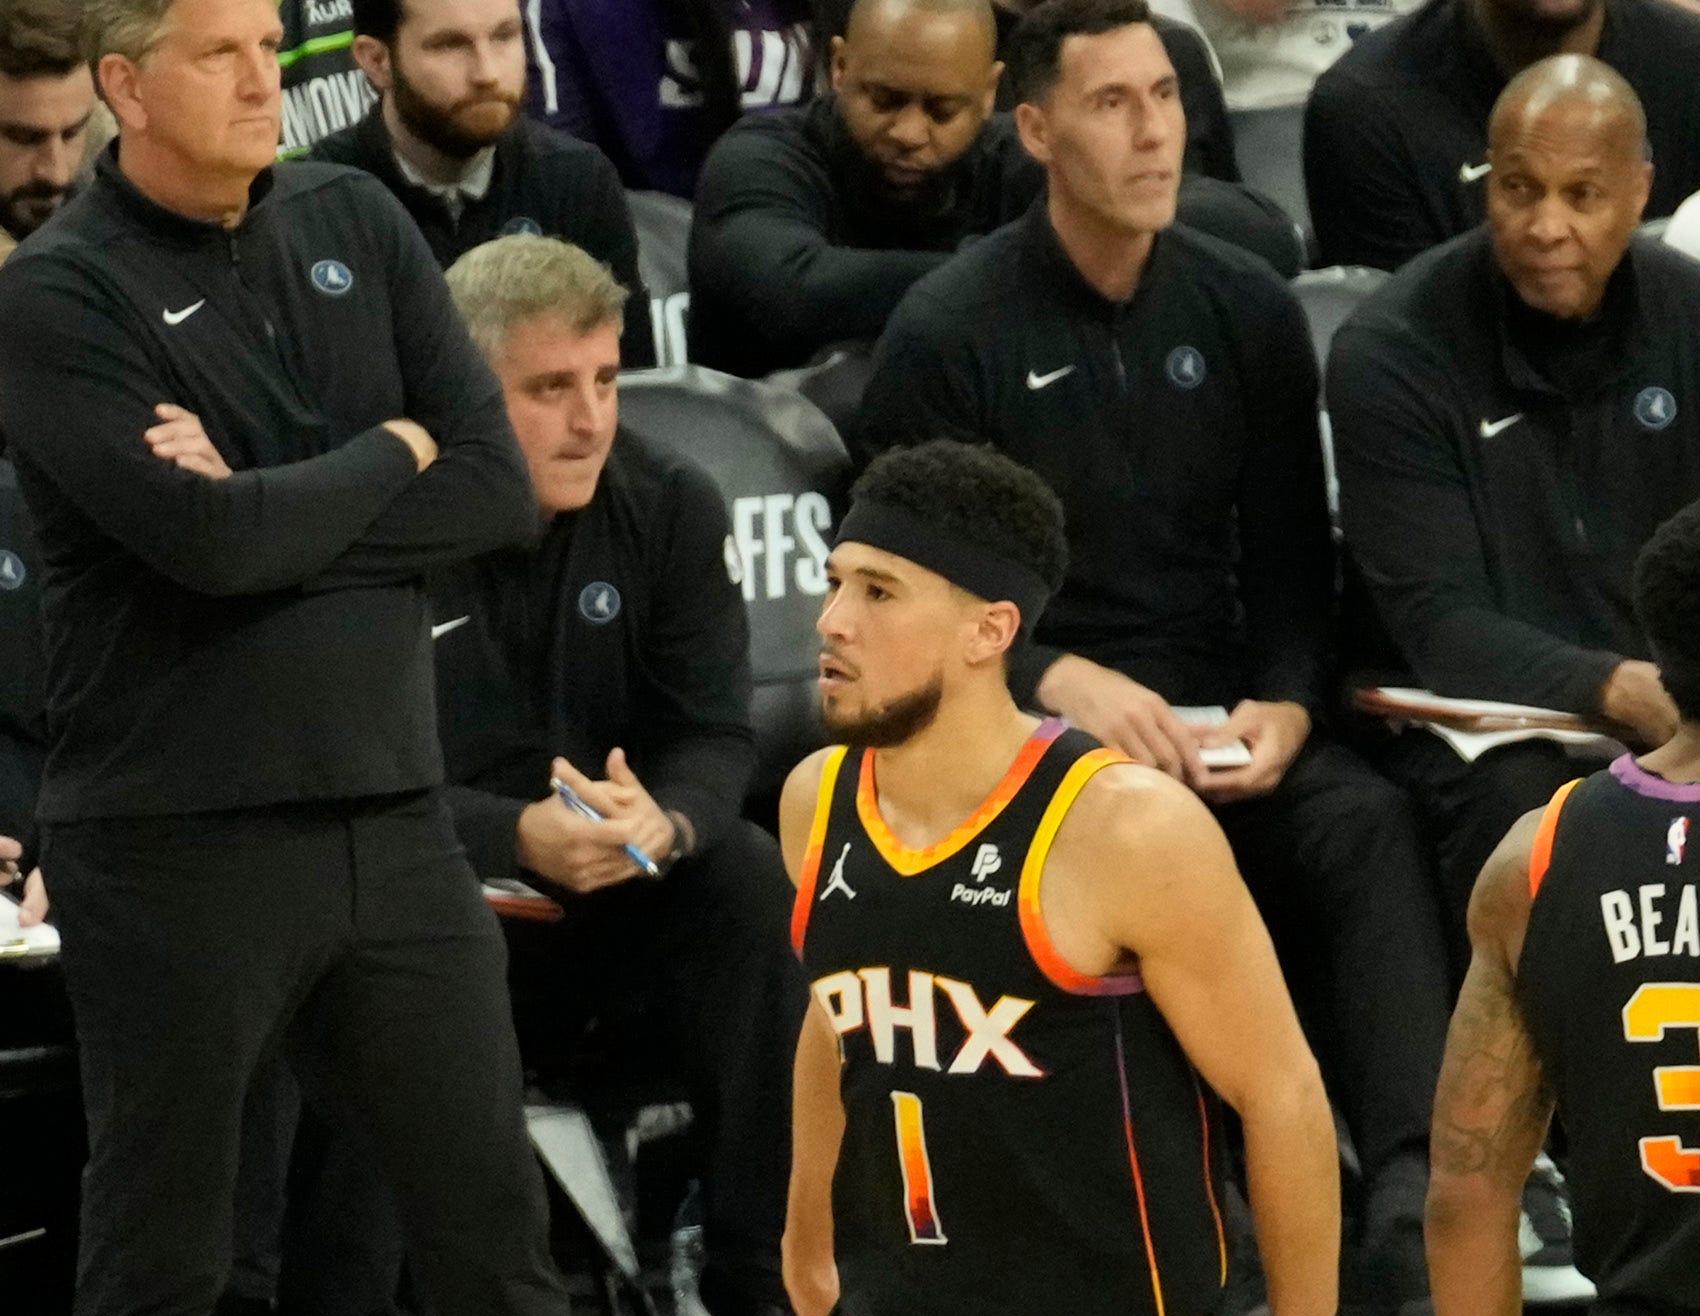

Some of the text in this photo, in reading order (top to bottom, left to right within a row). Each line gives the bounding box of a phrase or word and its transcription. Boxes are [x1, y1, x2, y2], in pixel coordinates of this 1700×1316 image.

[723, 491, 833, 601] FFS
[950, 883, 1012, 907] PayPal
[810, 966, 1047, 1079] PHX
[890, 1089, 949, 1246] 1
